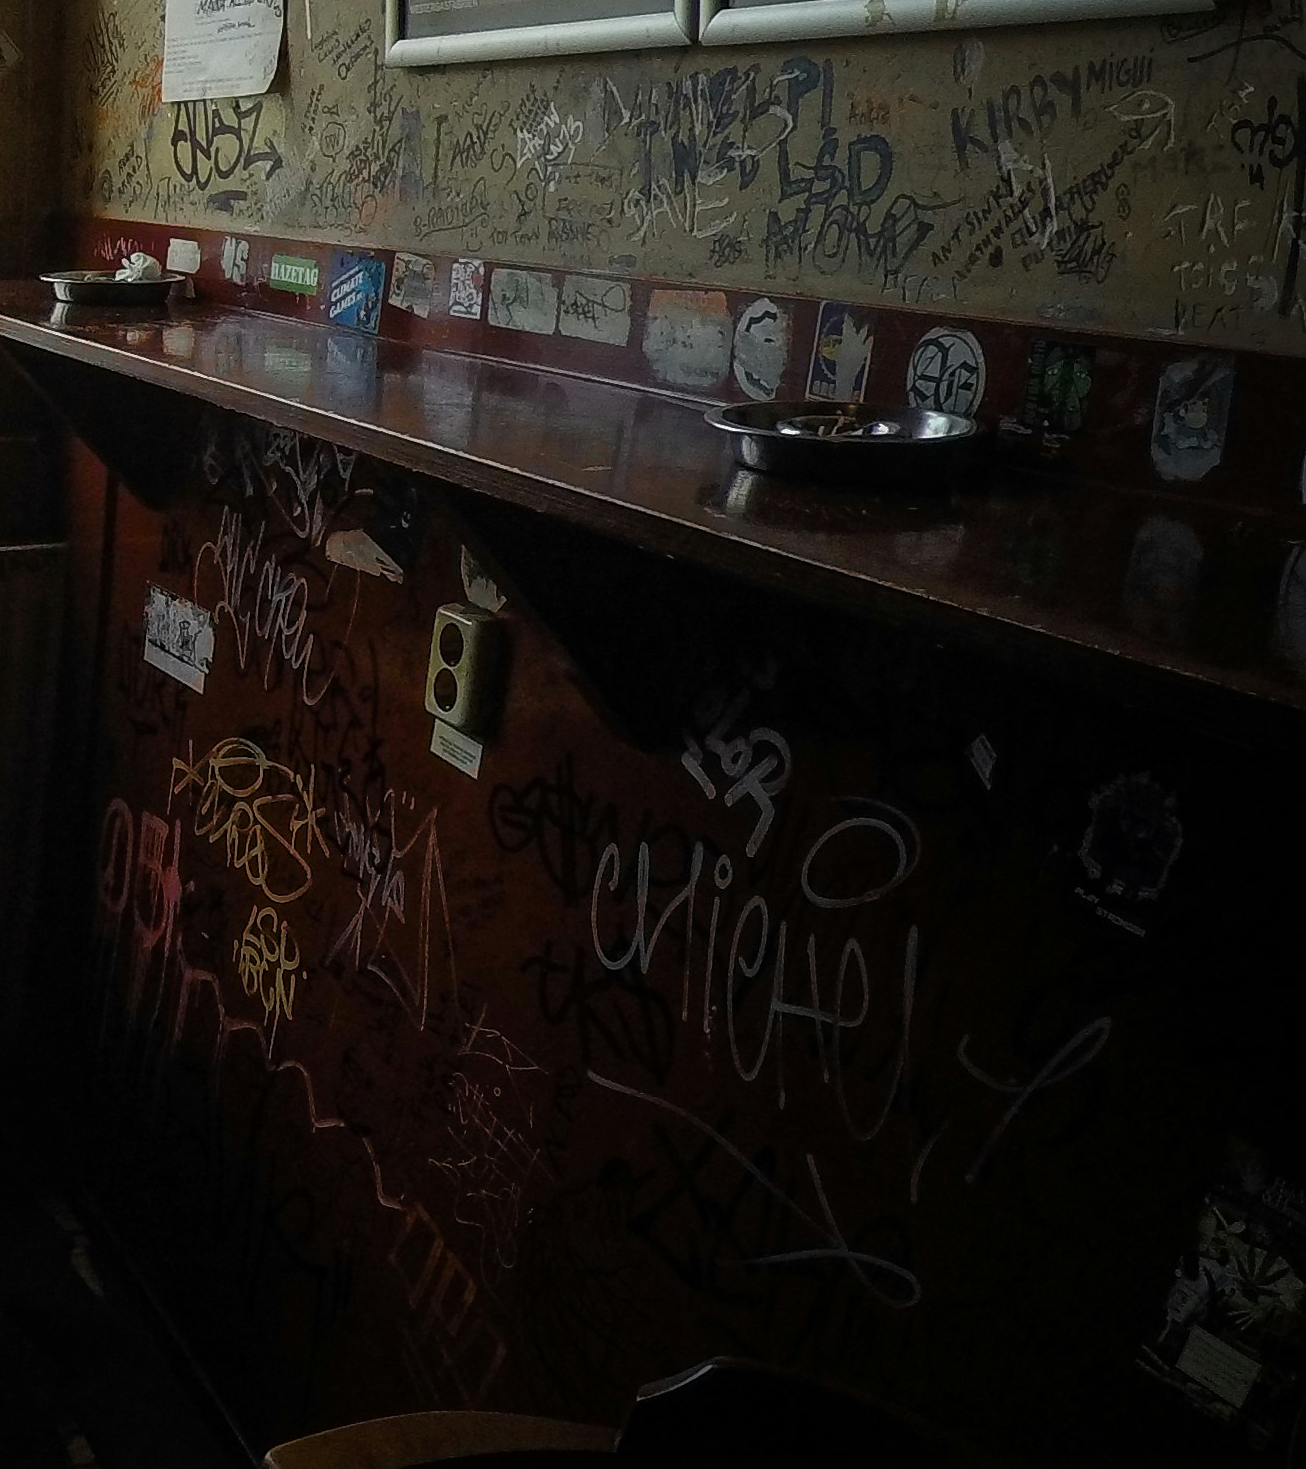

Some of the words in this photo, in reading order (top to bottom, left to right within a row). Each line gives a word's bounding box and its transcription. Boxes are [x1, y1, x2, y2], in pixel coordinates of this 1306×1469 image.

[951, 65, 1083, 172] KIRBY
[330, 271, 365, 302] CLIMATE
[328, 294, 357, 319] GAMES
